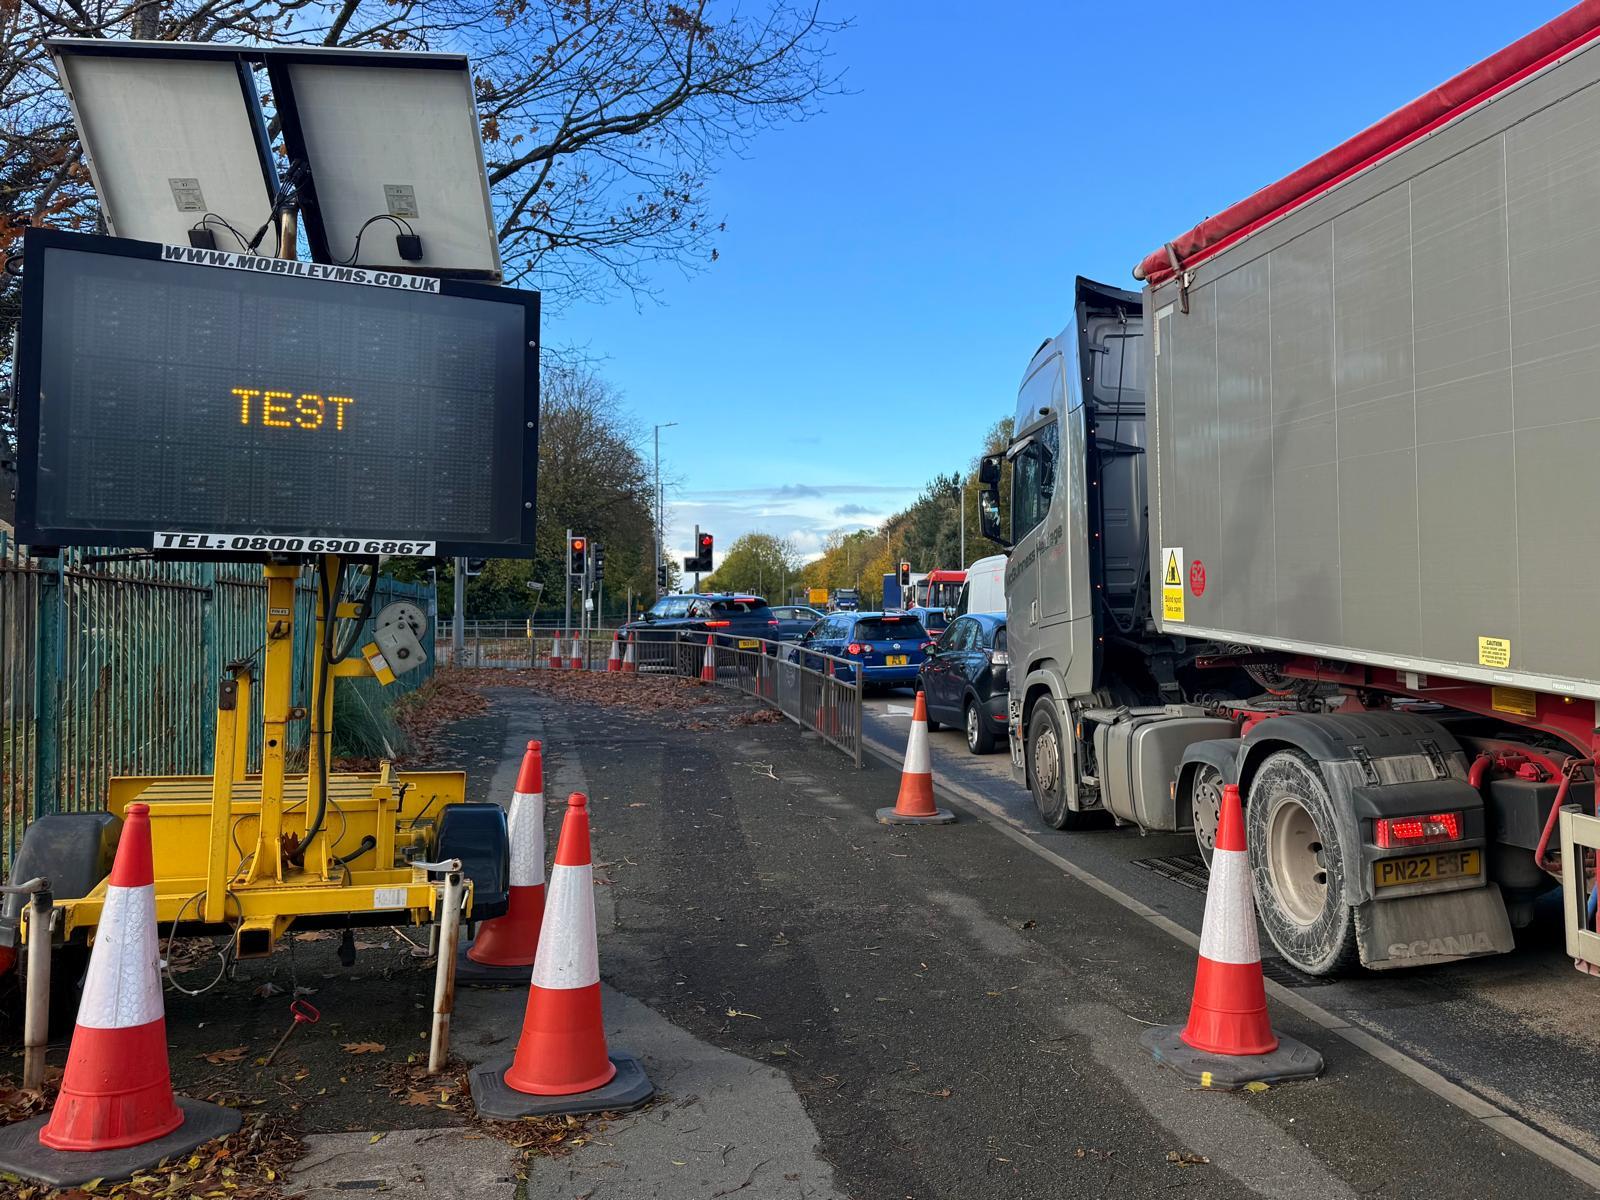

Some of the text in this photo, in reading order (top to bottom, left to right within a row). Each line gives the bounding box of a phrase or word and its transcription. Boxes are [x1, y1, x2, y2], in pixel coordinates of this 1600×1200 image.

[164, 245, 439, 292] WWW.MOBILEVMS.CO.UK
[231, 388, 354, 430] TEST
[160, 533, 431, 555] TEL: 0800 690 6867
[1382, 858, 1431, 882] PN22
[1388, 932, 1497, 960] SCANIA
